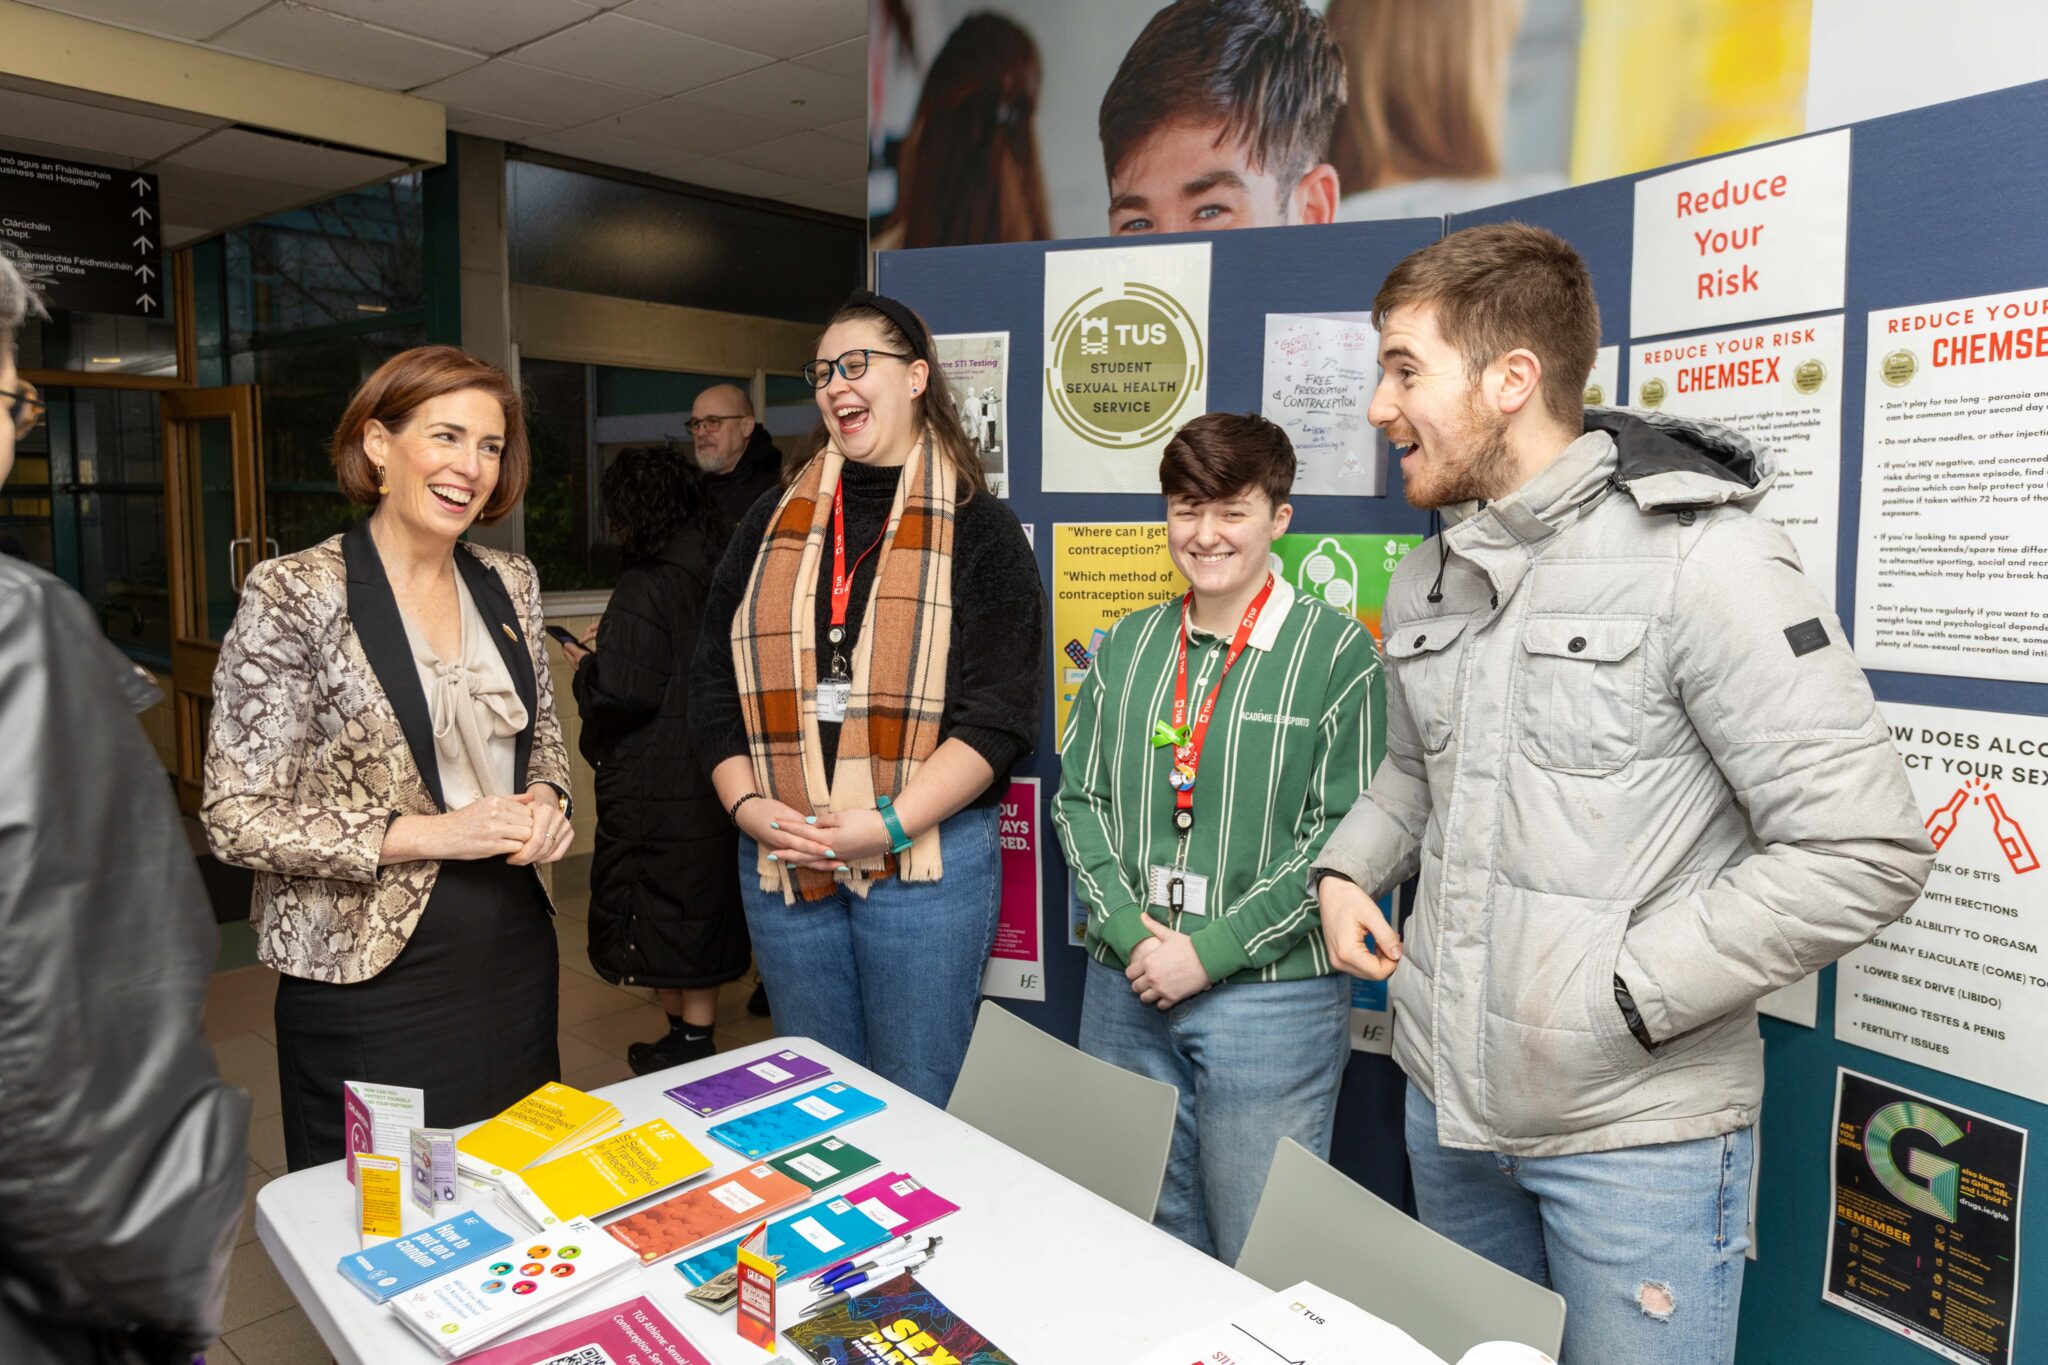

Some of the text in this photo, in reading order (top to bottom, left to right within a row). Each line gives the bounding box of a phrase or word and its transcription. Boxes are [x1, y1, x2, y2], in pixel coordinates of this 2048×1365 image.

[18, 160, 39, 169] agus
[42, 162, 53, 170] an
[0, 166, 100, 189] usiness and Hospitality
[1676, 173, 1788, 219] Reduce
[7, 228, 31, 239] Dept.
[1694, 224, 1765, 257] Your
[56, 264, 85, 275] Offices
[1697, 264, 1759, 300] Risk
[1888, 309, 1974, 334] REDUCE
[1114, 323, 1167, 346] TUS
[1644, 328, 1815, 365] REDUCE YOUR RISK
[1932, 327, 2048, 368] CHEMSE
[954, 359, 998, 368] STI Testing
[1090, 362, 1152, 374] STUDENT
[1304, 374, 1334, 385] FREE
[1677, 356, 1780, 394] CHEMSEX
[1066, 382, 1176, 394] SEXUAL HEALTH
[1294, 384, 1348, 395] PRESCRIPTION
[1283, 395, 1356, 409] CONTRACEPTION
[1960, 392, 2031, 404] long paranoia
[1093, 402, 1151, 413] SERVICE
[1916, 403, 2044, 419] common your second day
[1773, 419, 1821, 429] comfortable
[1978, 457, 1996, 465] and
[1998, 454, 2048, 464] concerned
[1905, 467, 2044, 481] during chemsex find
[1883, 485, 1920, 493] medicine
[1968, 482, 1988, 492] help
[1990, 482, 2024, 491] protect
[2026, 483, 2044, 491] you
[1882, 493, 2031, 507] positive taken within 72 hours of
[1068, 526, 1167, 539] "Where can I get
[1915, 532, 2009, 543] looking spend your
[1068, 544, 1166, 557] contraception?"
[1889, 557, 2005, 566] alternative social
[1063, 570, 1174, 582] "Which method of
[2006, 571, 2034, 579] break
[1059, 588, 1177, 602] contraception suits
[1944, 619, 2006, 631] psychological
[1913, 642, 2009, 655] non-sexual recreation
[1203, 698, 1213, 713] TUS
[1175, 708, 1183, 724] TUS
[1921, 729, 2048, 758] DOES ALCO
[1941, 757, 2004, 781] YOUR
[1000, 820, 1029, 834] AYS
[1931, 863, 2001, 883] ISK OF STI'S
[1924, 890, 2019, 918] WITH ERECTIONS
[1915, 919, 2038, 954] ALBILITY TO ORGASM
[1890, 942, 2026, 985] MAY EJACULATE (COME)
[1863, 964, 2002, 1010] LOWER SEX DRIVE (LIBIDO)
[1862, 993, 2006, 1040] SHRINKING TESTES & PENIS
[1861, 1021, 1950, 1055] FERTILITY ISSUES
[517, 1102, 576, 1130] Transmitted
[526, 1098, 566, 1118] Sexually
[1840, 1122, 1854, 1131] ARE
[1840, 1130, 1855, 1140] YOU
[1838, 1137, 1862, 1151] USING
[626, 1140, 659, 1171] Sexually
[601, 1150, 638, 1185] Infections
[615, 1144, 660, 1187] Transmitted
[1961, 1168, 2005, 1189] also known
[1960, 1184, 2009, 1207] and Liquid E
[1959, 1197, 2009, 1222] drugs.ie/ghb
[1837, 1205, 1911, 1244] REMEMBER
[434, 1223, 471, 1249] How to
[395, 1240, 437, 1269] condom
[412, 1232, 456, 1260] put on a
[748, 1270, 761, 1280] PEP
[1303, 1309, 1326, 1326] TUS
[613, 1314, 653, 1355] Contraception
[632, 1309, 689, 1365] TUS Athlone Sexual
[880, 1318, 962, 1365] SEX
[851, 1339, 875, 1358] FIRST
[1212, 1351, 1231, 1365] STI
